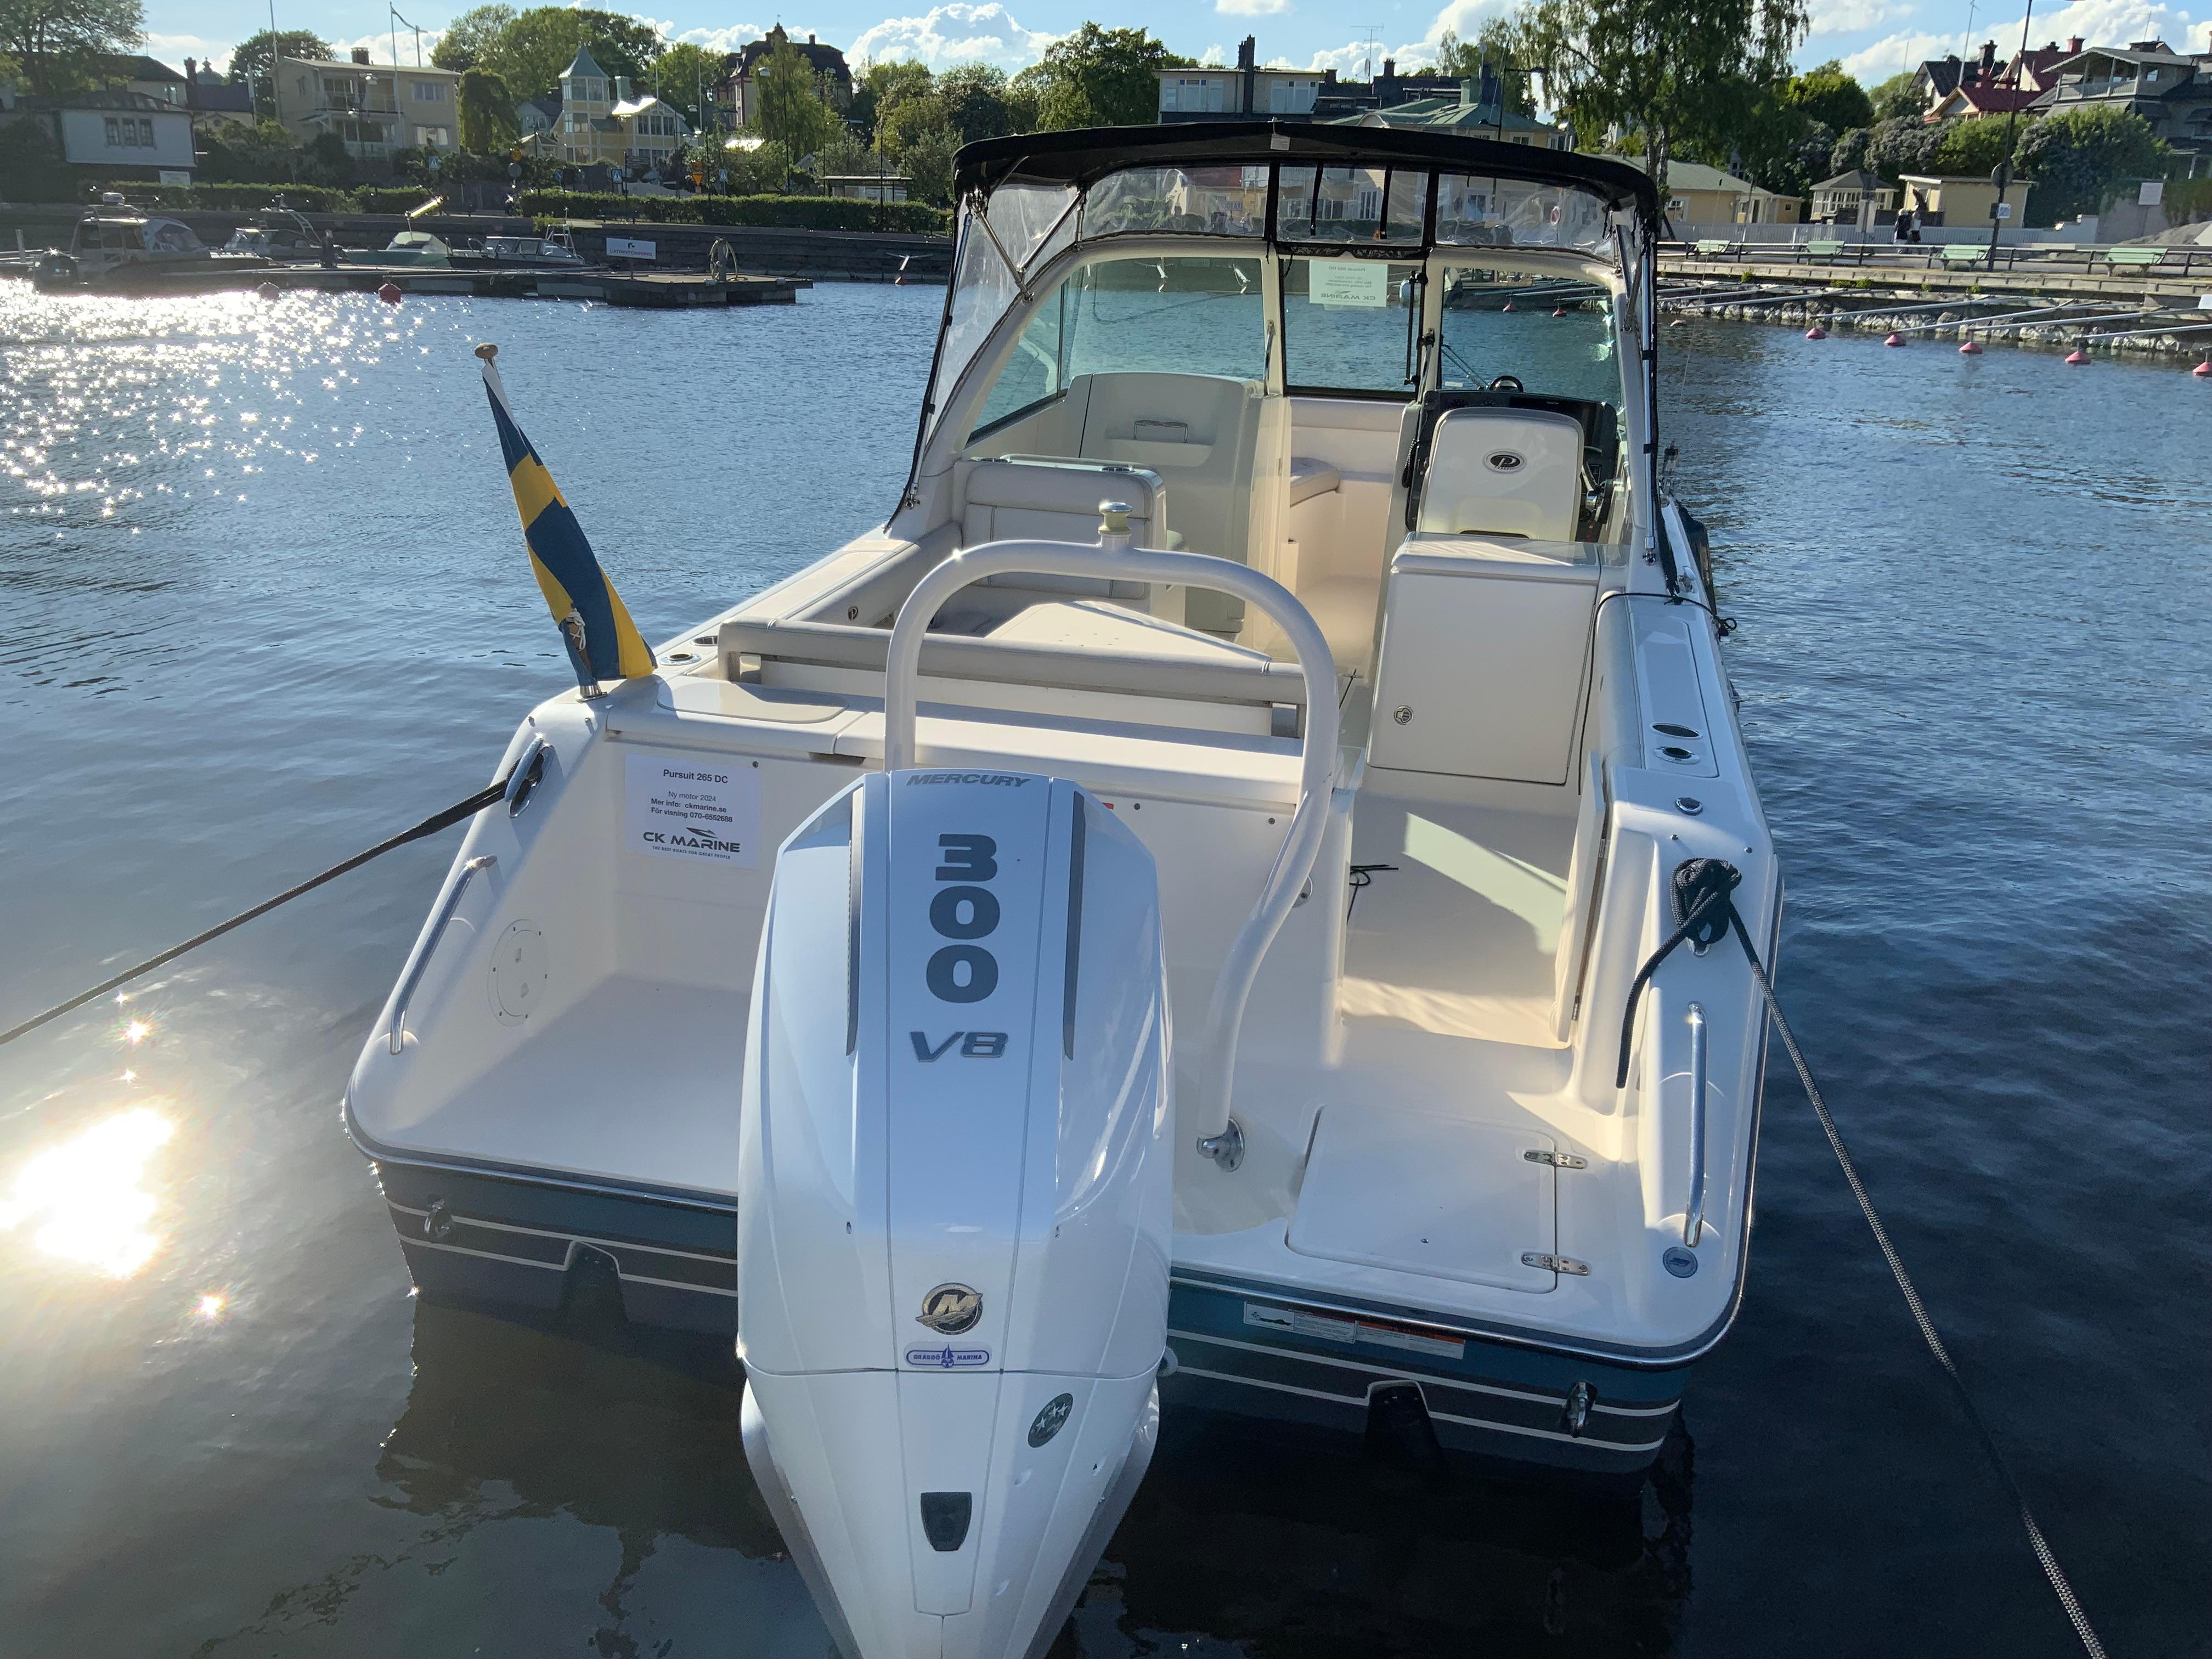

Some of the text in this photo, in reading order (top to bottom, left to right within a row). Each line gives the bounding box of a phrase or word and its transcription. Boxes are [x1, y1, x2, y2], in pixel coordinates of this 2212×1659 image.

[663, 769, 729, 783] Pursuit 265 DC
[906, 773, 1031, 787] MERCURY
[666, 799, 681, 808] info:
[685, 802, 727, 812] ckmarine.se
[664, 809, 688, 819] visning
[690, 812, 733, 822] 070-6552688
[643, 832, 741, 853] CK MARINE
[926, 833, 1001, 1003] 300
[909, 1031, 1008, 1063] V8
